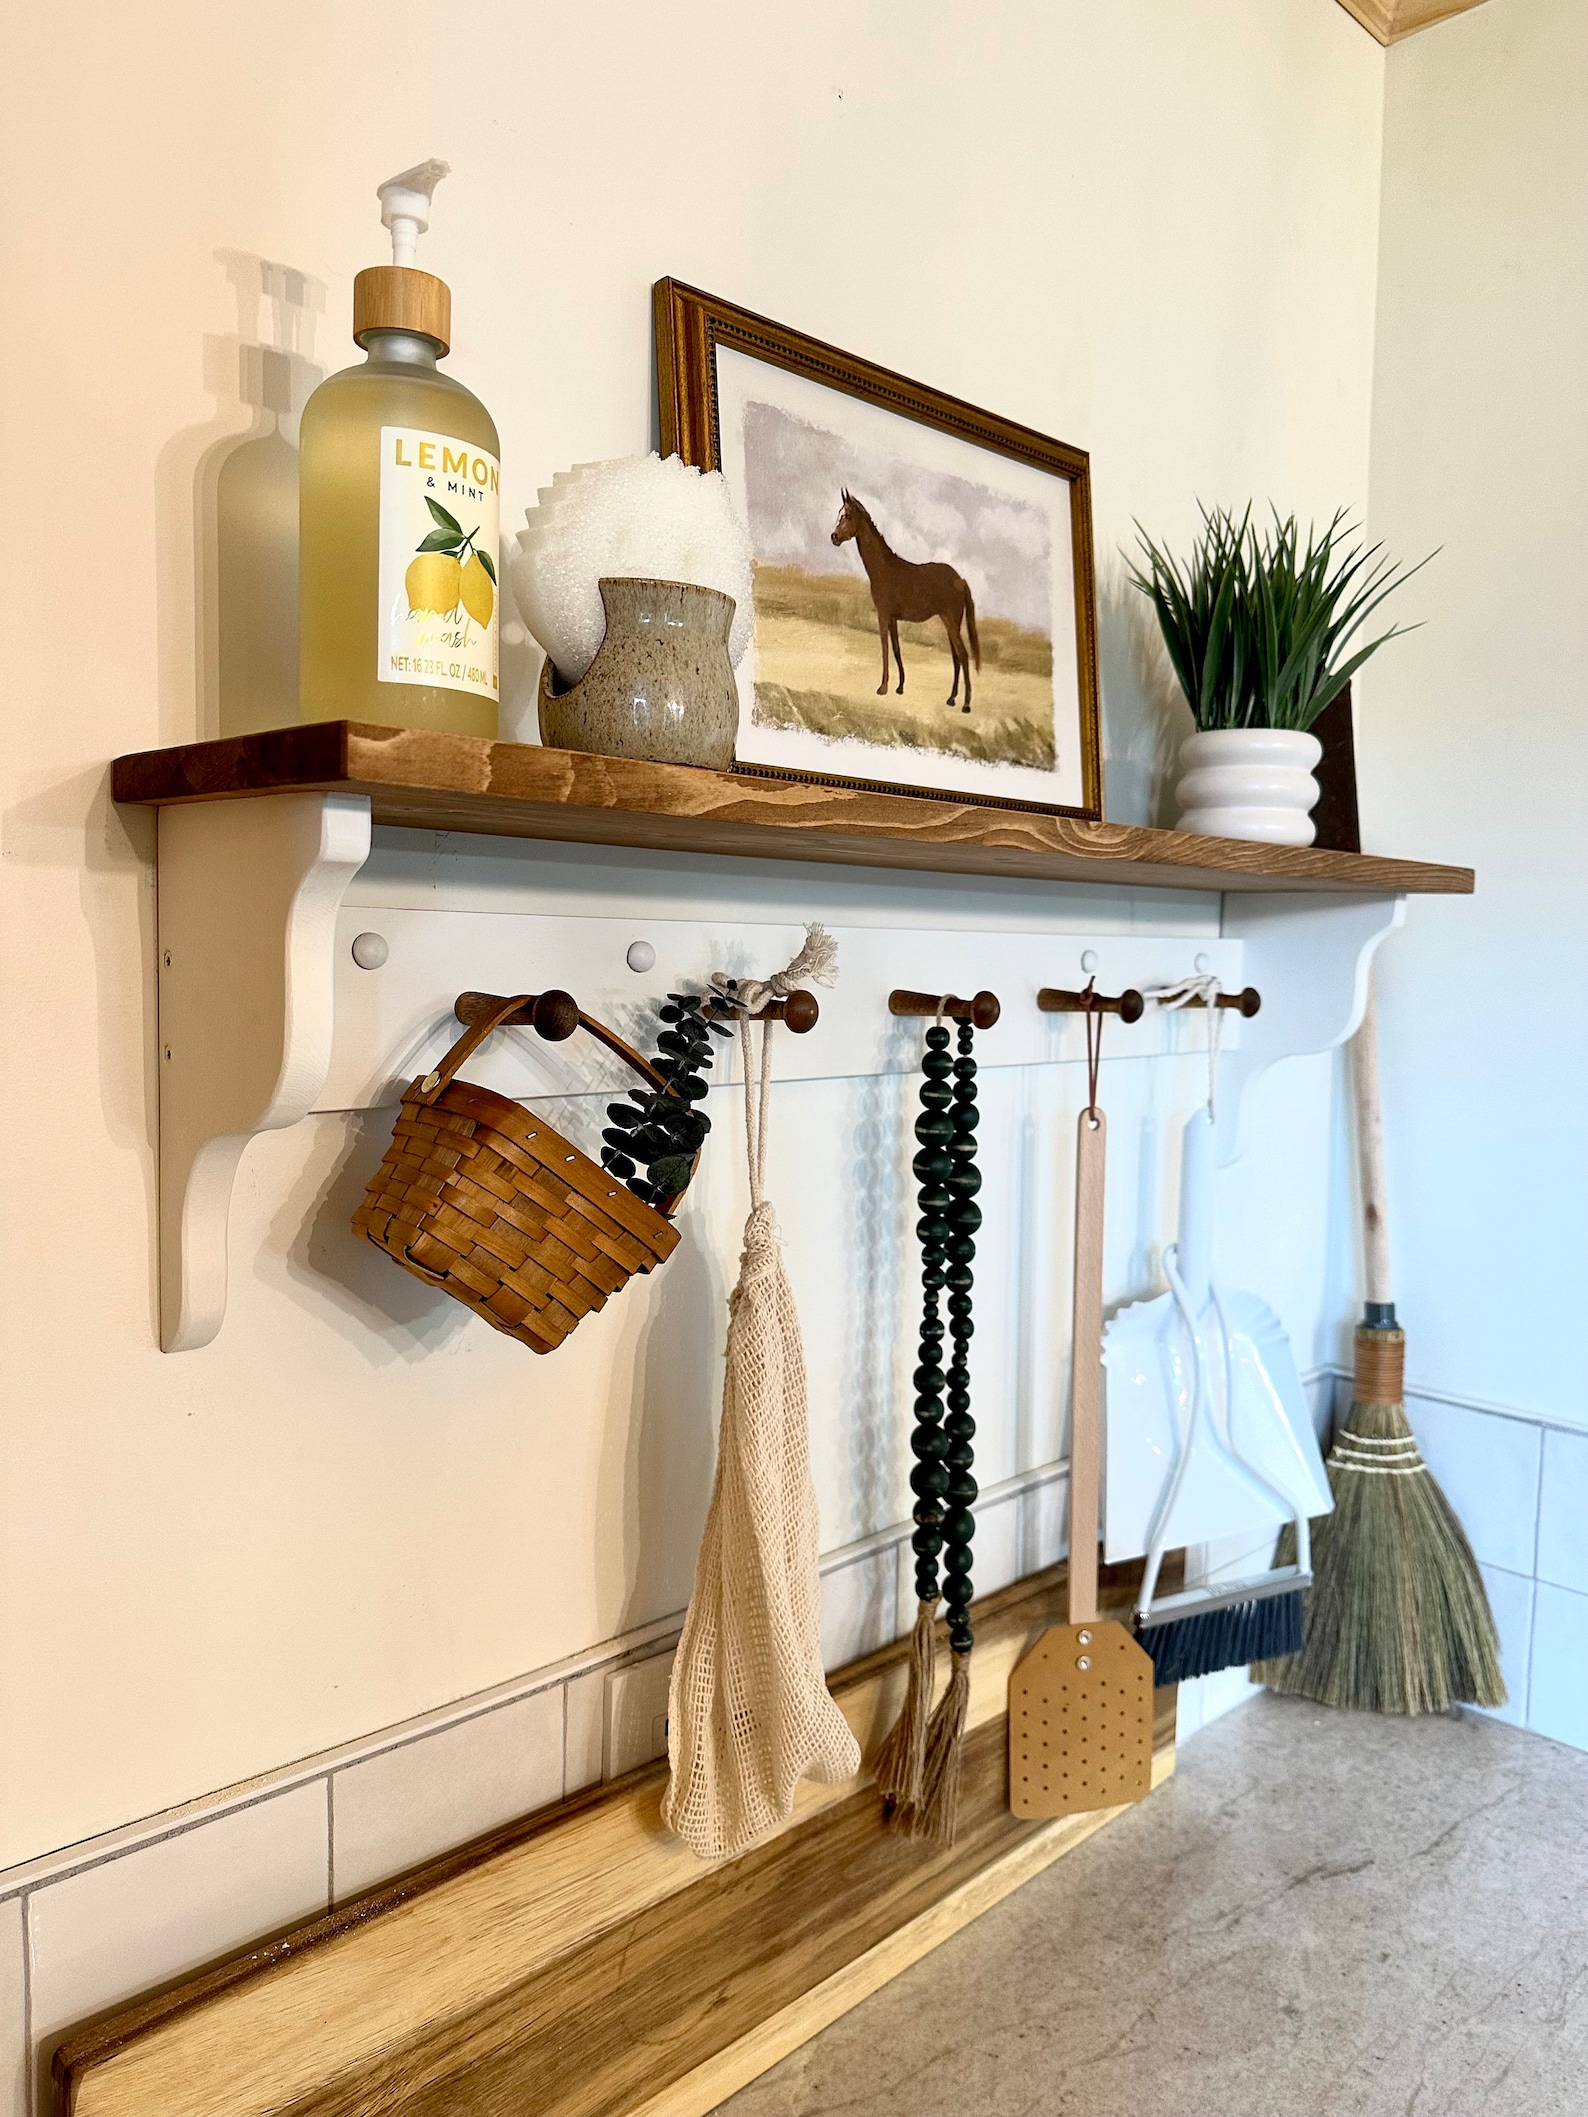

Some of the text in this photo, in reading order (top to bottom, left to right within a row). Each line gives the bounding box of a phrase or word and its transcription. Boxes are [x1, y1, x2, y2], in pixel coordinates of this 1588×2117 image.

[396, 439, 498, 496] LEMON
[426, 477, 484, 501] & MINT
[391, 656, 411, 672] NET:
[449, 663, 461, 679] OZ
